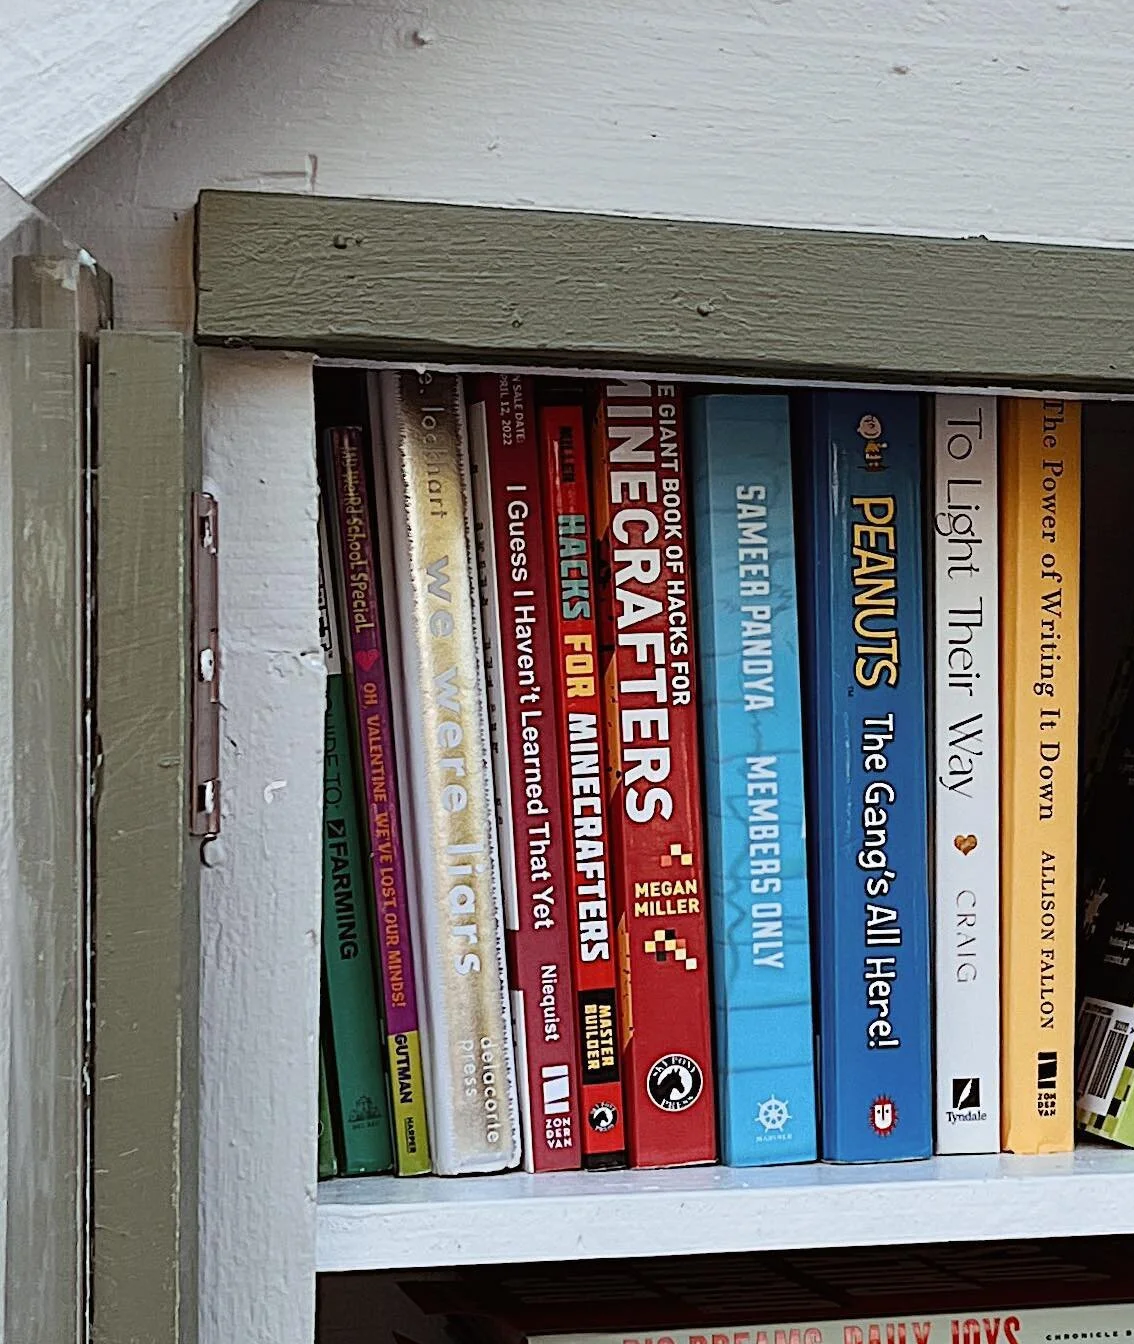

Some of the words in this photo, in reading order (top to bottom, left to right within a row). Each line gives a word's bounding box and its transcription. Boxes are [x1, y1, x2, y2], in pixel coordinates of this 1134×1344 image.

[659, 404, 679, 472] GIANT
[948, 408, 983, 460] To
[1041, 399, 1065, 448] The
[662, 479, 682, 537] BOOK
[934, 479, 983, 579] Light
[1041, 460, 1063, 543] Power
[507, 501, 531, 582] Guess
[557, 515, 591, 620] HACKS
[664, 546, 683, 573] OF
[736, 486, 770, 596] SAMEER
[1041, 554, 1062, 583] of
[426, 556, 454, 639] we
[668, 581, 687, 655] HACKS
[851, 496, 899, 690] PEANUTS
[514, 606, 540, 703] Haven't
[564, 635, 595, 697] FOR
[740, 607, 775, 711] PANDYA
[948, 597, 983, 697] Their
[1034, 589, 1062, 698] Writing
[671, 662, 691, 705] FOR
[1040, 708, 1060, 731] It
[435, 667, 472, 813] were
[521, 711, 549, 815] Learned
[862, 713, 894, 771] The
[939, 713, 984, 800] Way
[1039, 741, 1061, 821] Down
[528, 822, 552, 881] That
[568, 713, 609, 961] MINECRAFTERS
[746, 757, 782, 892] MEMBERS
[857, 782, 895, 896] Gang's
[328, 843, 358, 960] FARMING
[446, 844, 485, 975] liars
[532, 885, 555, 928] Yet
[635, 883, 697, 897] MEGAN
[635, 901, 700, 917] MILLER
[867, 904, 901, 946] All
[1040, 851, 1055, 941] ALLISON
[751, 903, 785, 968] ONLY
[956, 890, 978, 984] CRAIG
[539, 965, 560, 1042] Niequist
[866, 957, 898, 1048] Here!
[1040, 949, 1054, 1029] FALLON
[393, 1034, 413, 1104] GUTMAN
[458, 1041, 478, 1096] press
[585, 1005, 599, 1070] BUILDER
[598, 1005, 614, 1066] MASTER
[479, 1037, 503, 1143] delacorte
[946, 1111, 987, 1122] Tyndale
[405, 1116, 417, 1154] HARPER
[1045, 1331, 1118, 1341] CHRONICLE
